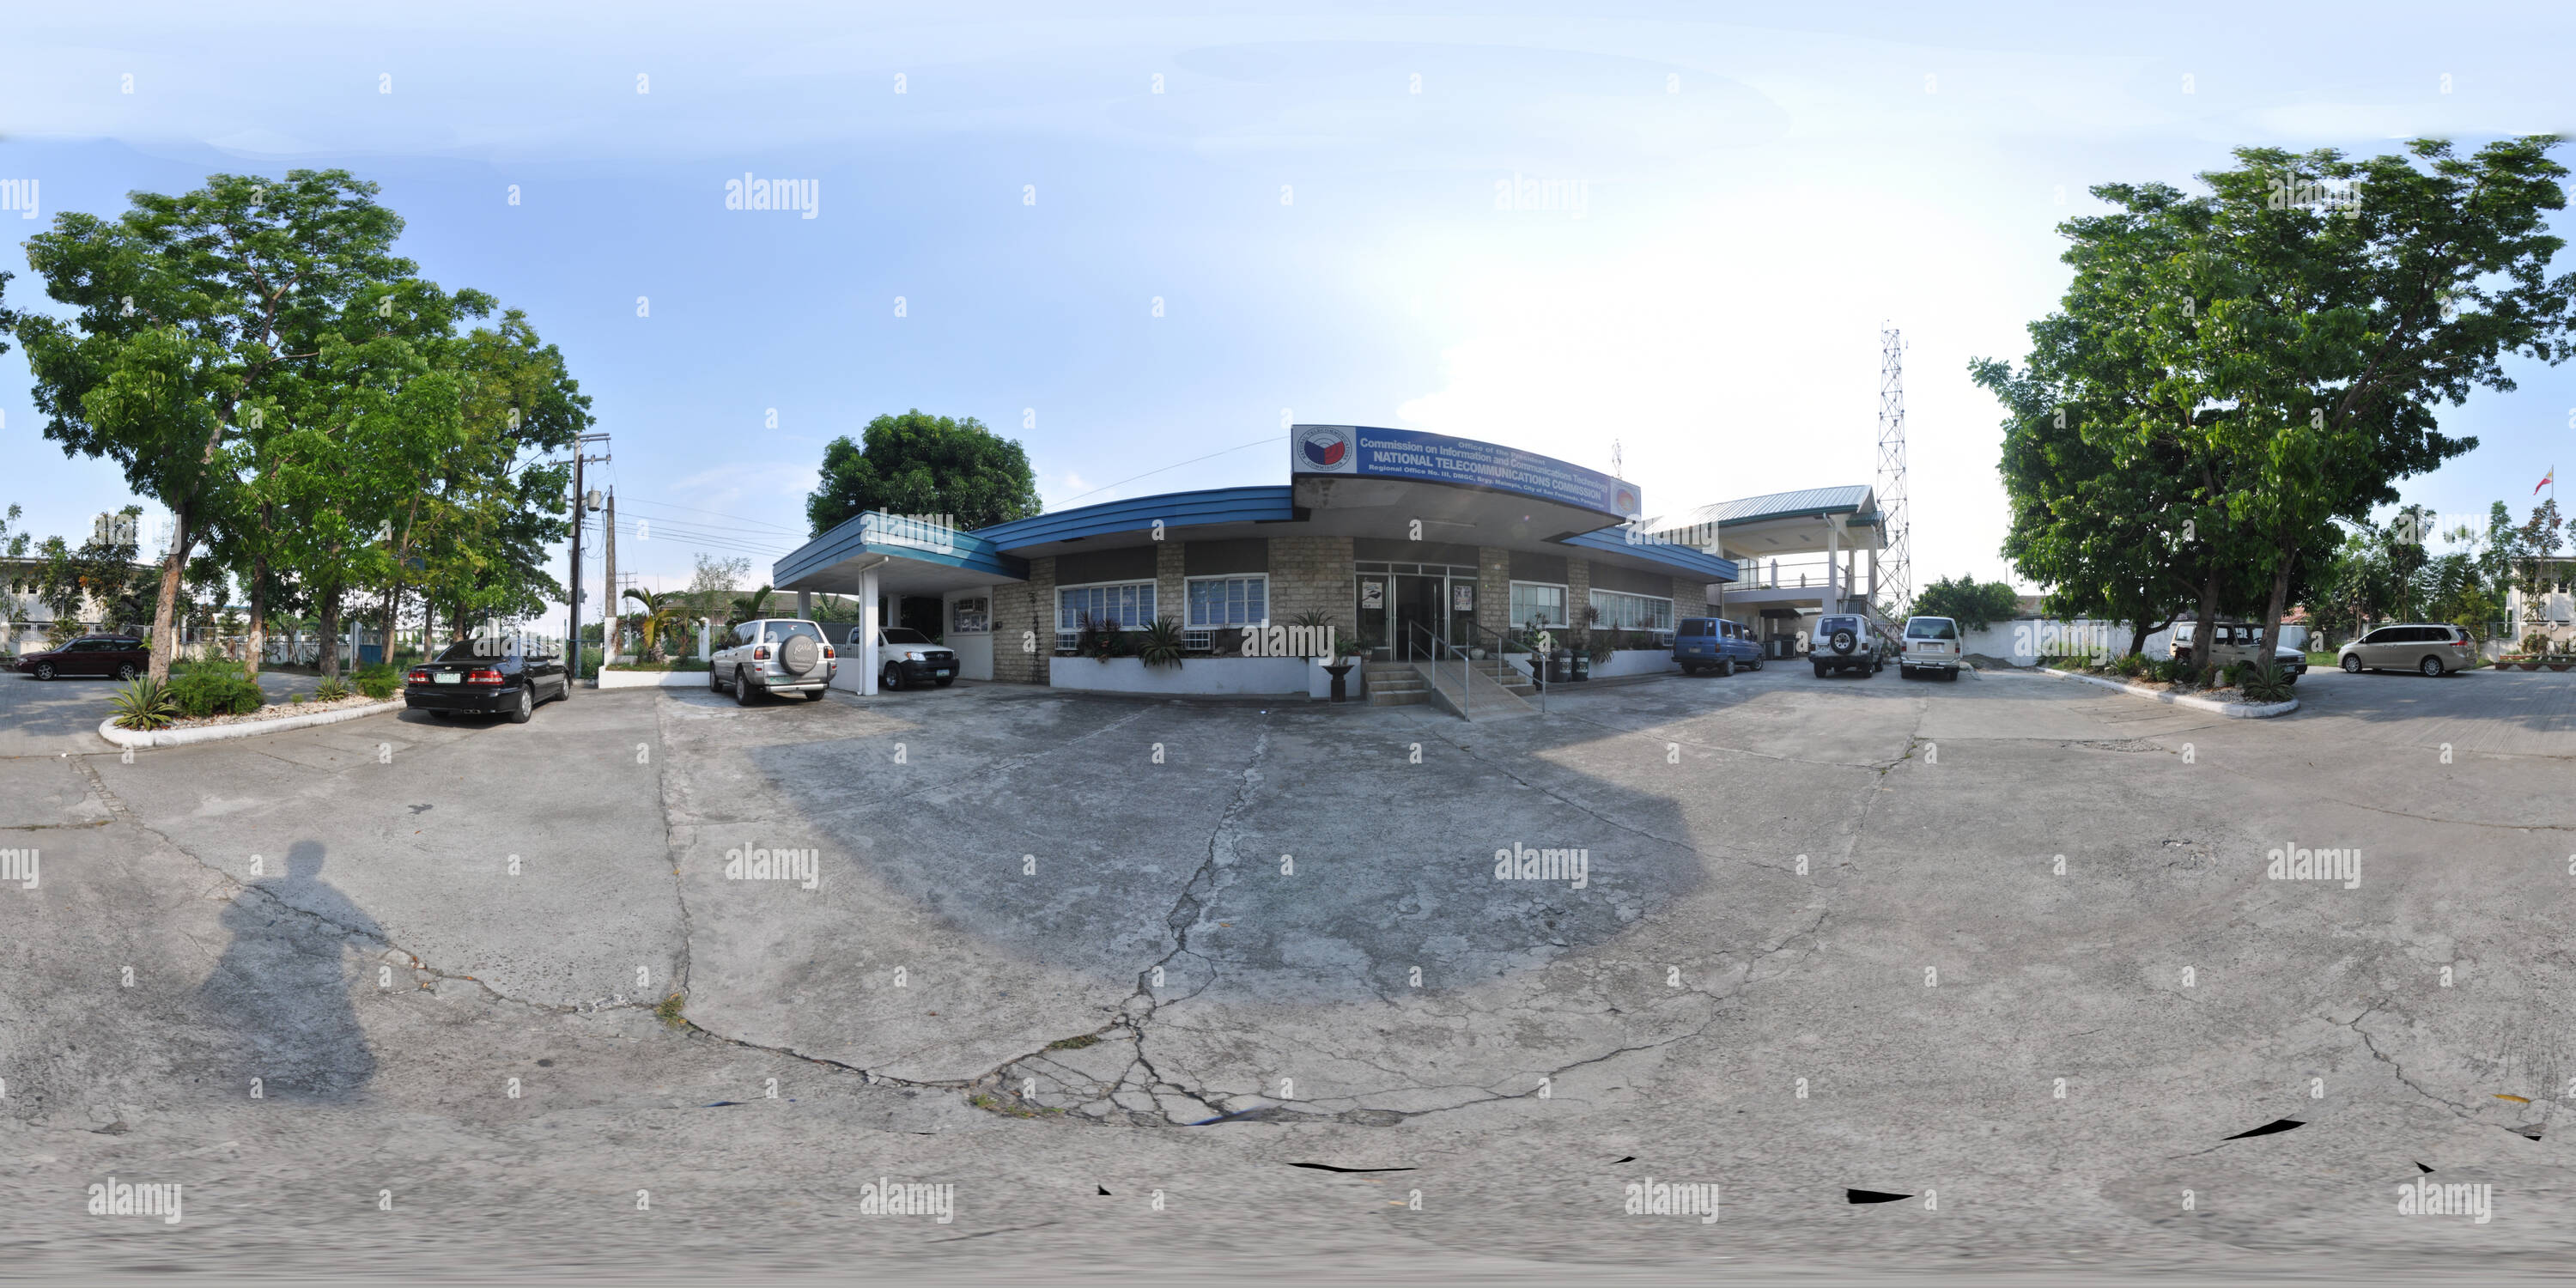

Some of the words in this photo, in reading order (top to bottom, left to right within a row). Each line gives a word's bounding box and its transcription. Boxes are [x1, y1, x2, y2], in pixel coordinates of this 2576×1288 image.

[1359, 437, 1423, 453] Commission
[1425, 446, 1437, 454] on
[1439, 446, 1492, 463] Information
[1493, 456, 1510, 466] and
[1511, 459, 1572, 482] Communications
[1573, 473, 1608, 495] Technology
[1458, 442, 1483, 453] Office
[1496, 448, 1510, 457] the
[1511, 452, 1546, 465] President
[1368, 464, 1402, 473] Regional
[1404, 467, 1425, 476] Office
[1523, 484, 1535, 493] City
[1374, 451, 1434, 467] NATIONAL
[1436, 457, 1550, 488] TELECOMMUNICATIONS
[1552, 479, 1601, 501] COMMISSION
